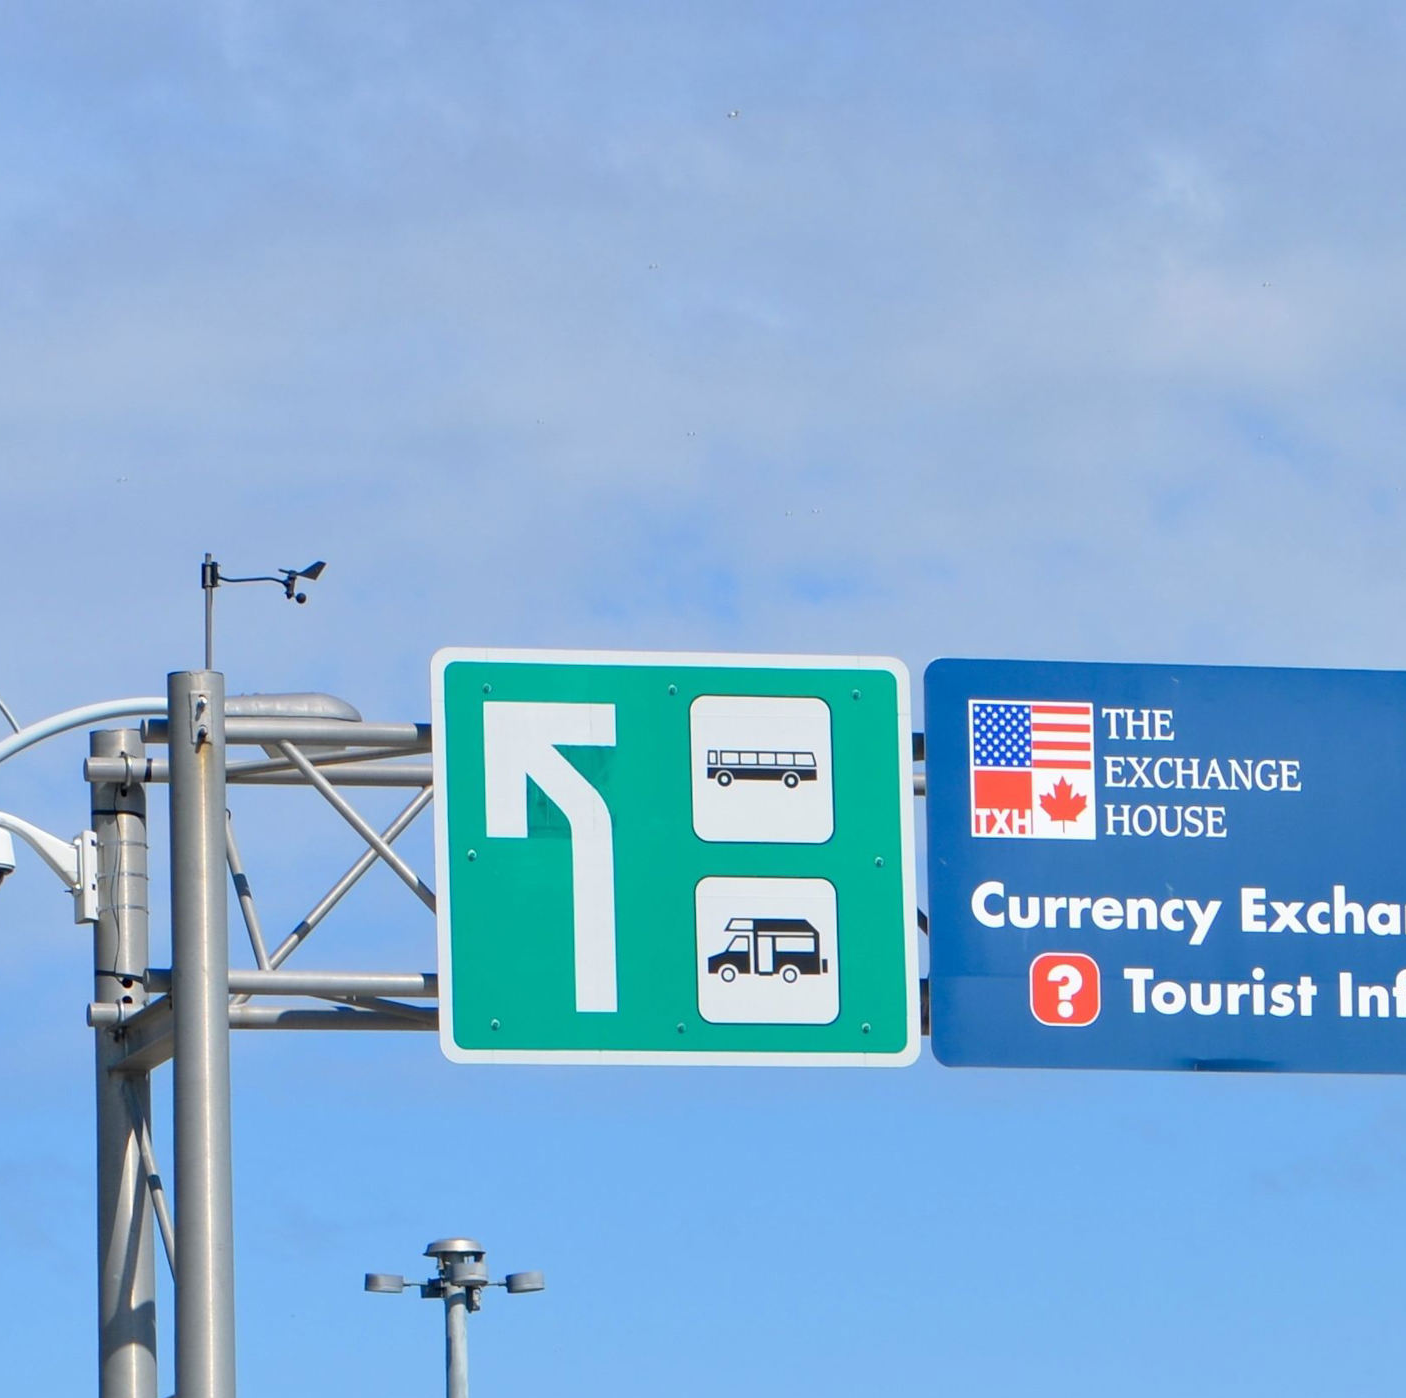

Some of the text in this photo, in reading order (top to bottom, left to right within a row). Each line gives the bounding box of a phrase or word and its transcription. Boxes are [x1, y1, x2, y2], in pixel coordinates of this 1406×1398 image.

[1101, 707, 1175, 741] THE
[1103, 755, 1302, 792] EXCHANGE
[974, 807, 1032, 835] TXH
[1104, 803, 1228, 838] HOUSE
[971, 880, 1223, 946] Currency
[1123, 966, 1318, 1017] Tourist
